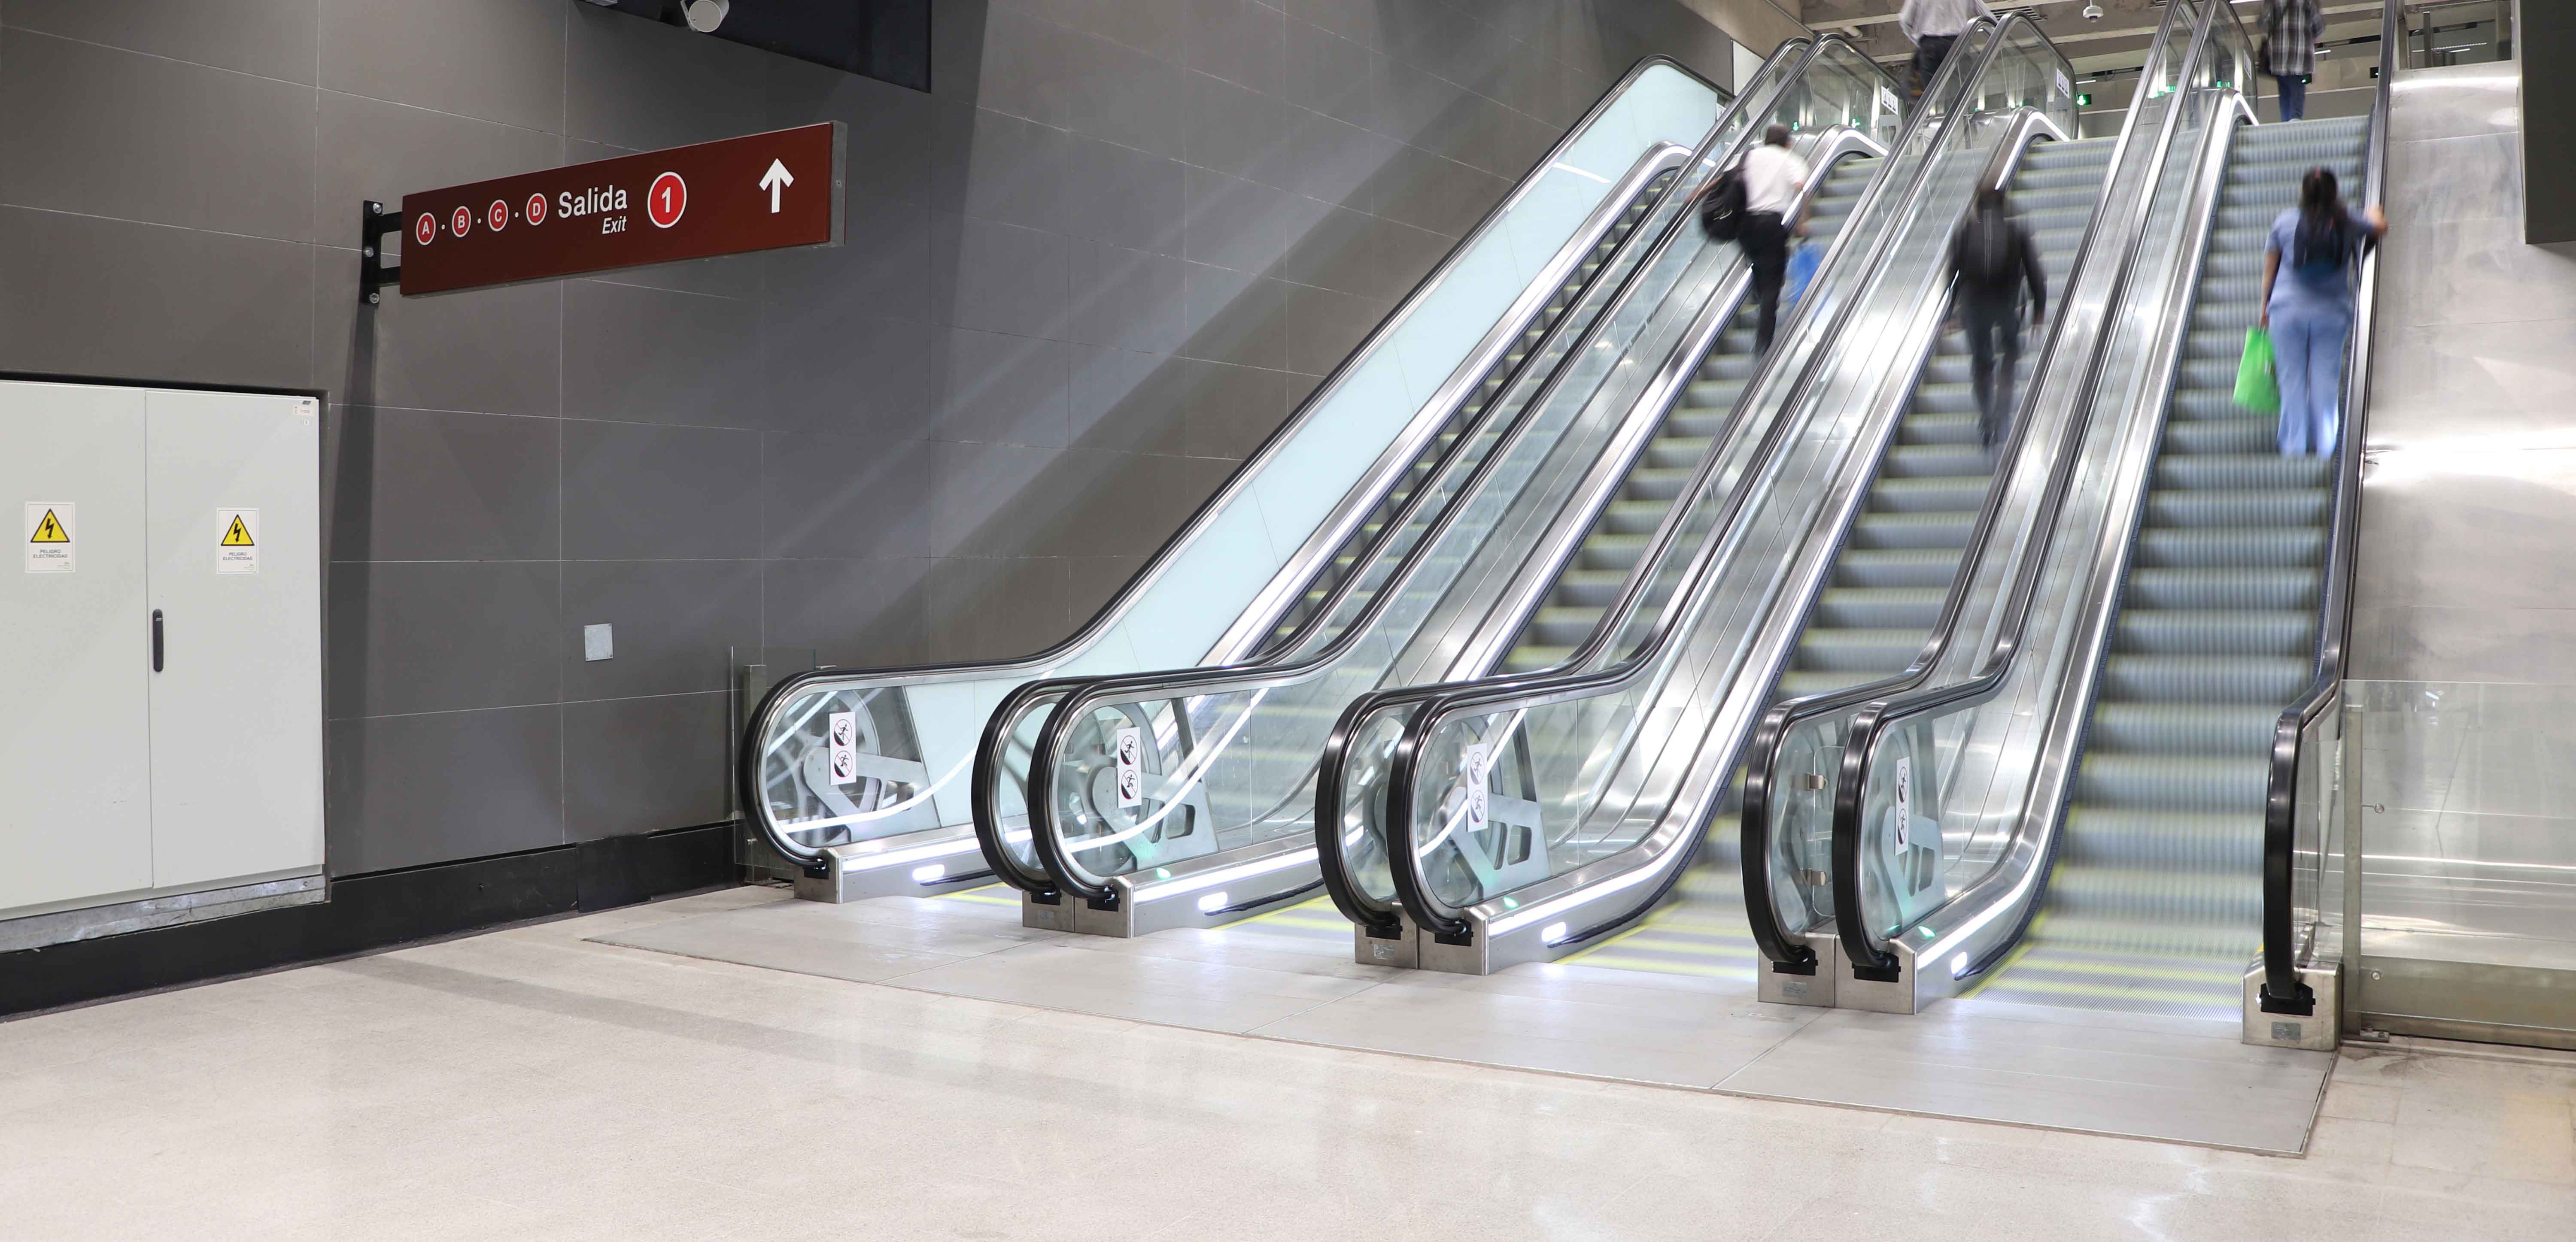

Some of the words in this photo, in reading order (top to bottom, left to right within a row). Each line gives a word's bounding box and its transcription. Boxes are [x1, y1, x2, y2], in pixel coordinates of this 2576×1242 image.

[422, 221, 430, 235] A
[458, 215, 465, 228] B
[494, 209, 502, 222] C
[532, 203, 541, 216] D
[558, 185, 627, 218] Salida
[662, 187, 671, 213] 1
[602, 216, 627, 234] Exit
